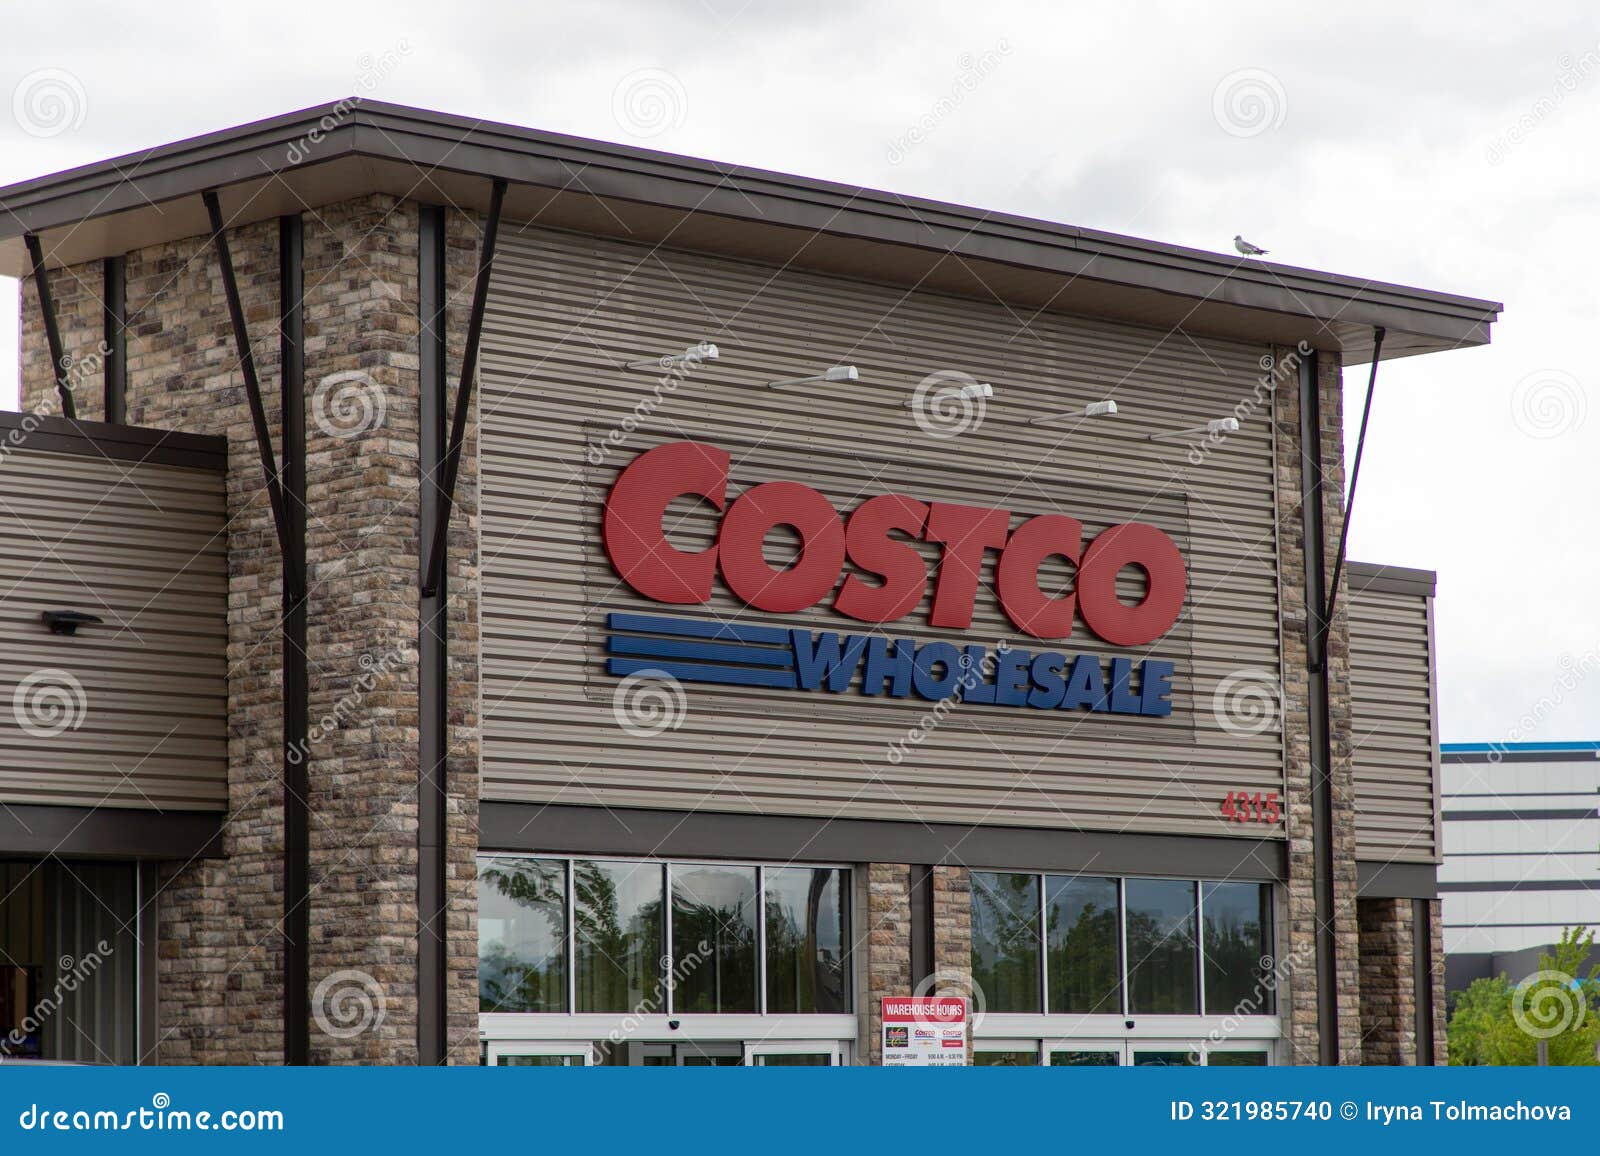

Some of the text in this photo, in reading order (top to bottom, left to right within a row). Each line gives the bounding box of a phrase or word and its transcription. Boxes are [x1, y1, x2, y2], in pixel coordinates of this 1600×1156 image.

[602, 441, 1187, 647] COSTCO
[789, 628, 1175, 716] WHOLESALE
[1221, 790, 1279, 824] 4315
[886, 1004, 962, 1016] WAREHOUSE HOURS
